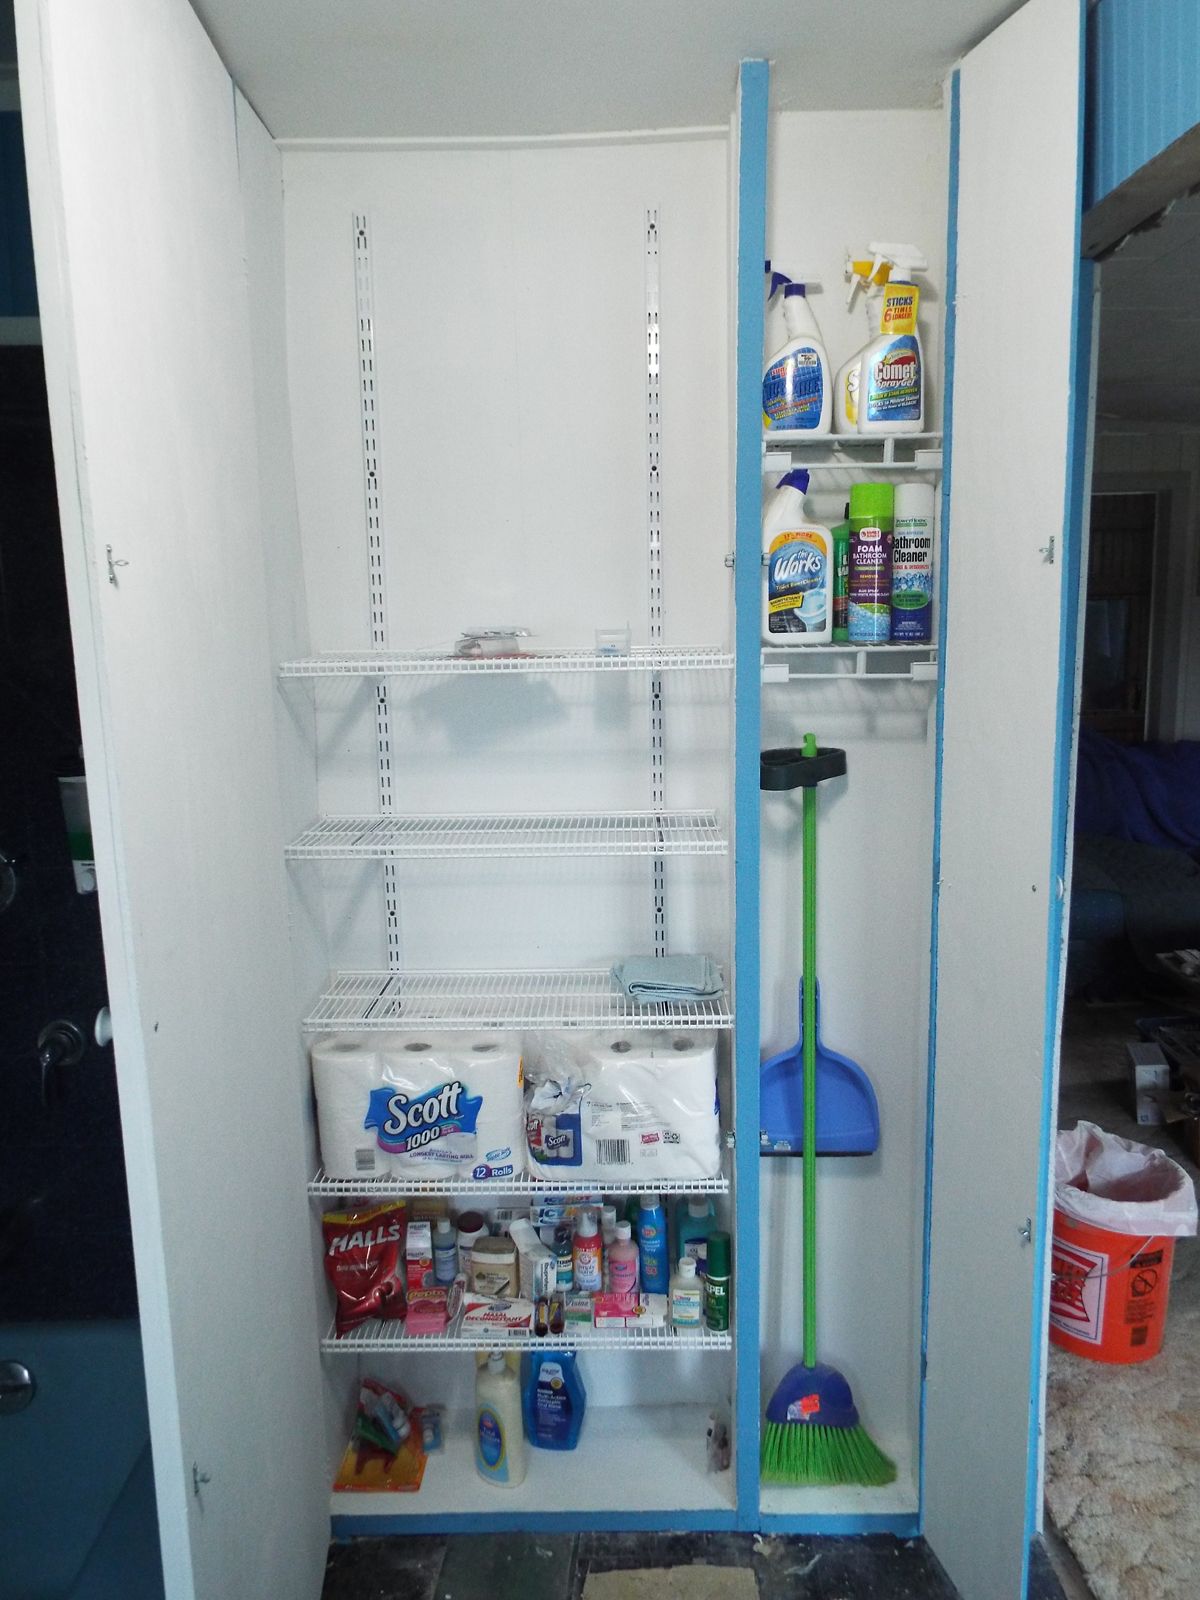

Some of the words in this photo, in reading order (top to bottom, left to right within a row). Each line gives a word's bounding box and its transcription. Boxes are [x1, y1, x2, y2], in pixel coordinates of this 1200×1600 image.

[886, 296, 913, 307] STICKS
[884, 307, 893, 323] 6
[874, 361, 917, 381] Comet
[797, 550, 808, 560] the
[857, 545, 882, 553] FOAM
[893, 549, 928, 563] Cleaner
[774, 552, 821, 581] Works
[384, 1081, 463, 1135] Scott
[406, 1126, 440, 1151] 1000
[548, 1135, 567, 1146] Scott
[476, 1166, 486, 1178] 12
[491, 1168, 513, 1177] Rolls
[329, 1224, 401, 1256] HALLS
